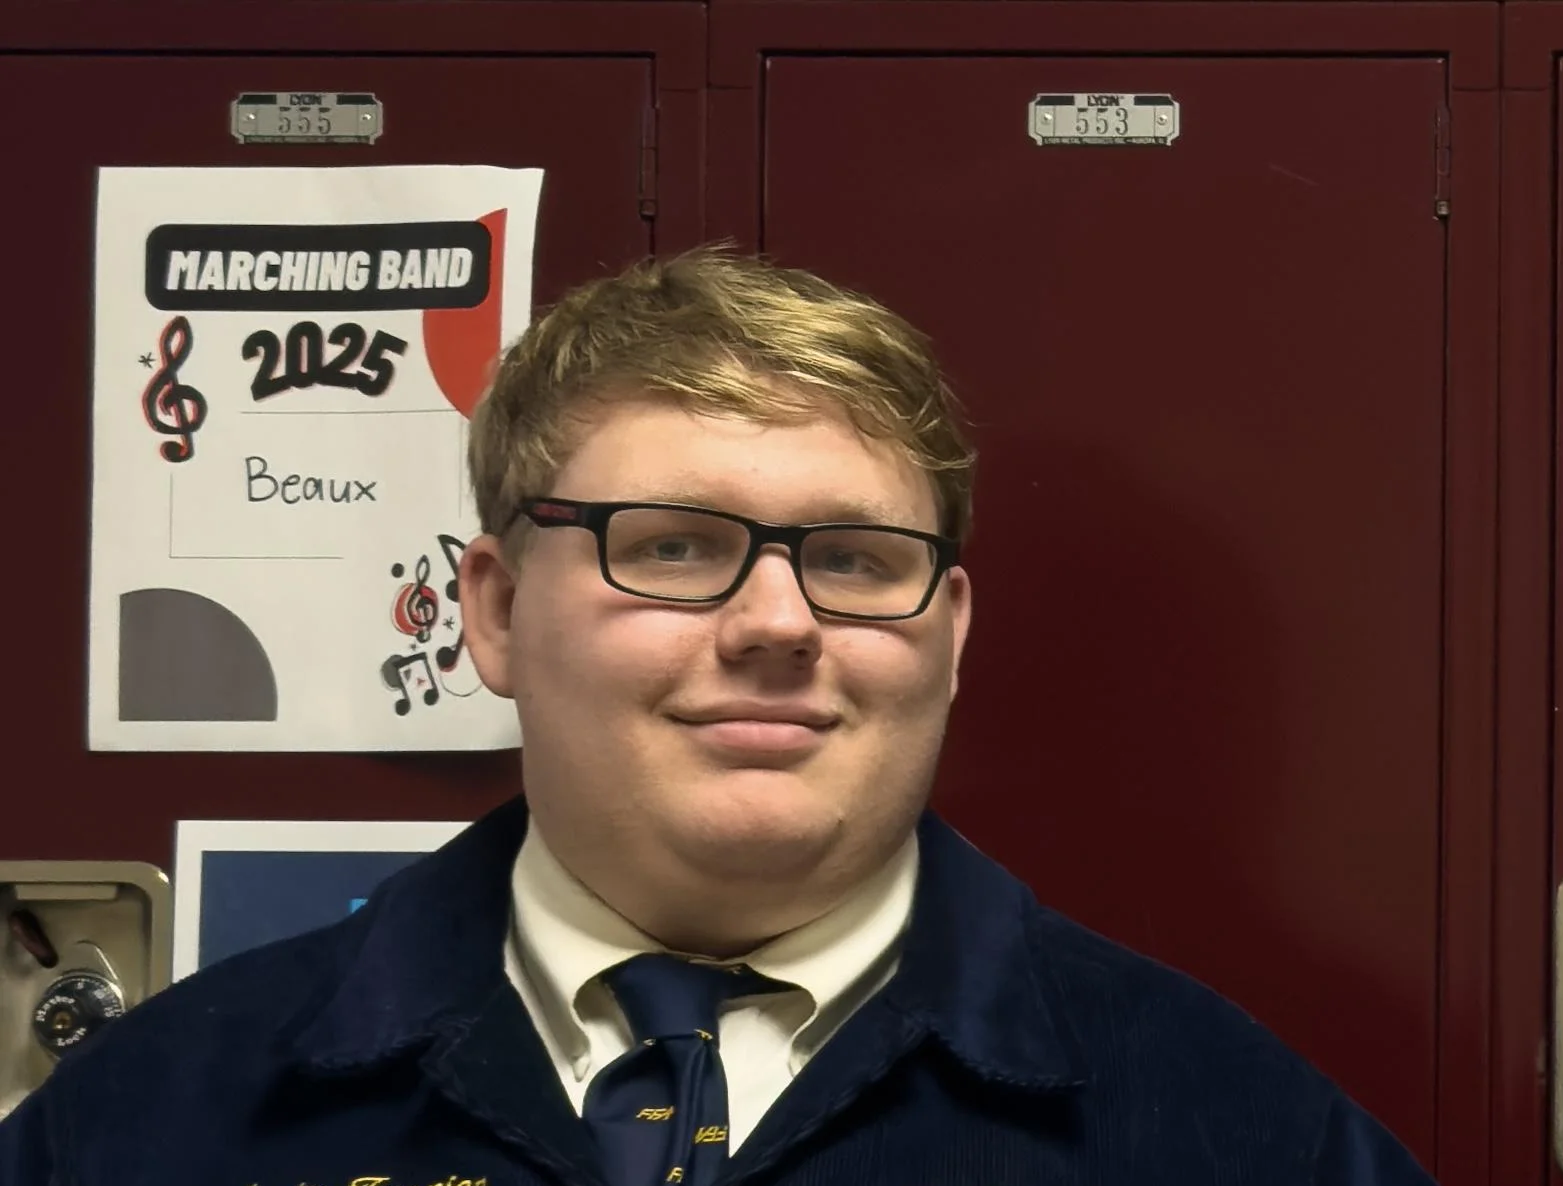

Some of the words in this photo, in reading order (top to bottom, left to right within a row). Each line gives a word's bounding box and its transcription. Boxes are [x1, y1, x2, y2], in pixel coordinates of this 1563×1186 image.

[1087, 95, 1120, 106] LYON
[278, 106, 331, 134] 555
[1075, 107, 1129, 135] 553
[165, 249, 371, 292] MARCHING
[377, 247, 473, 290] BAND
[241, 321, 409, 401] 2025
[245, 456, 378, 503] Beaux
